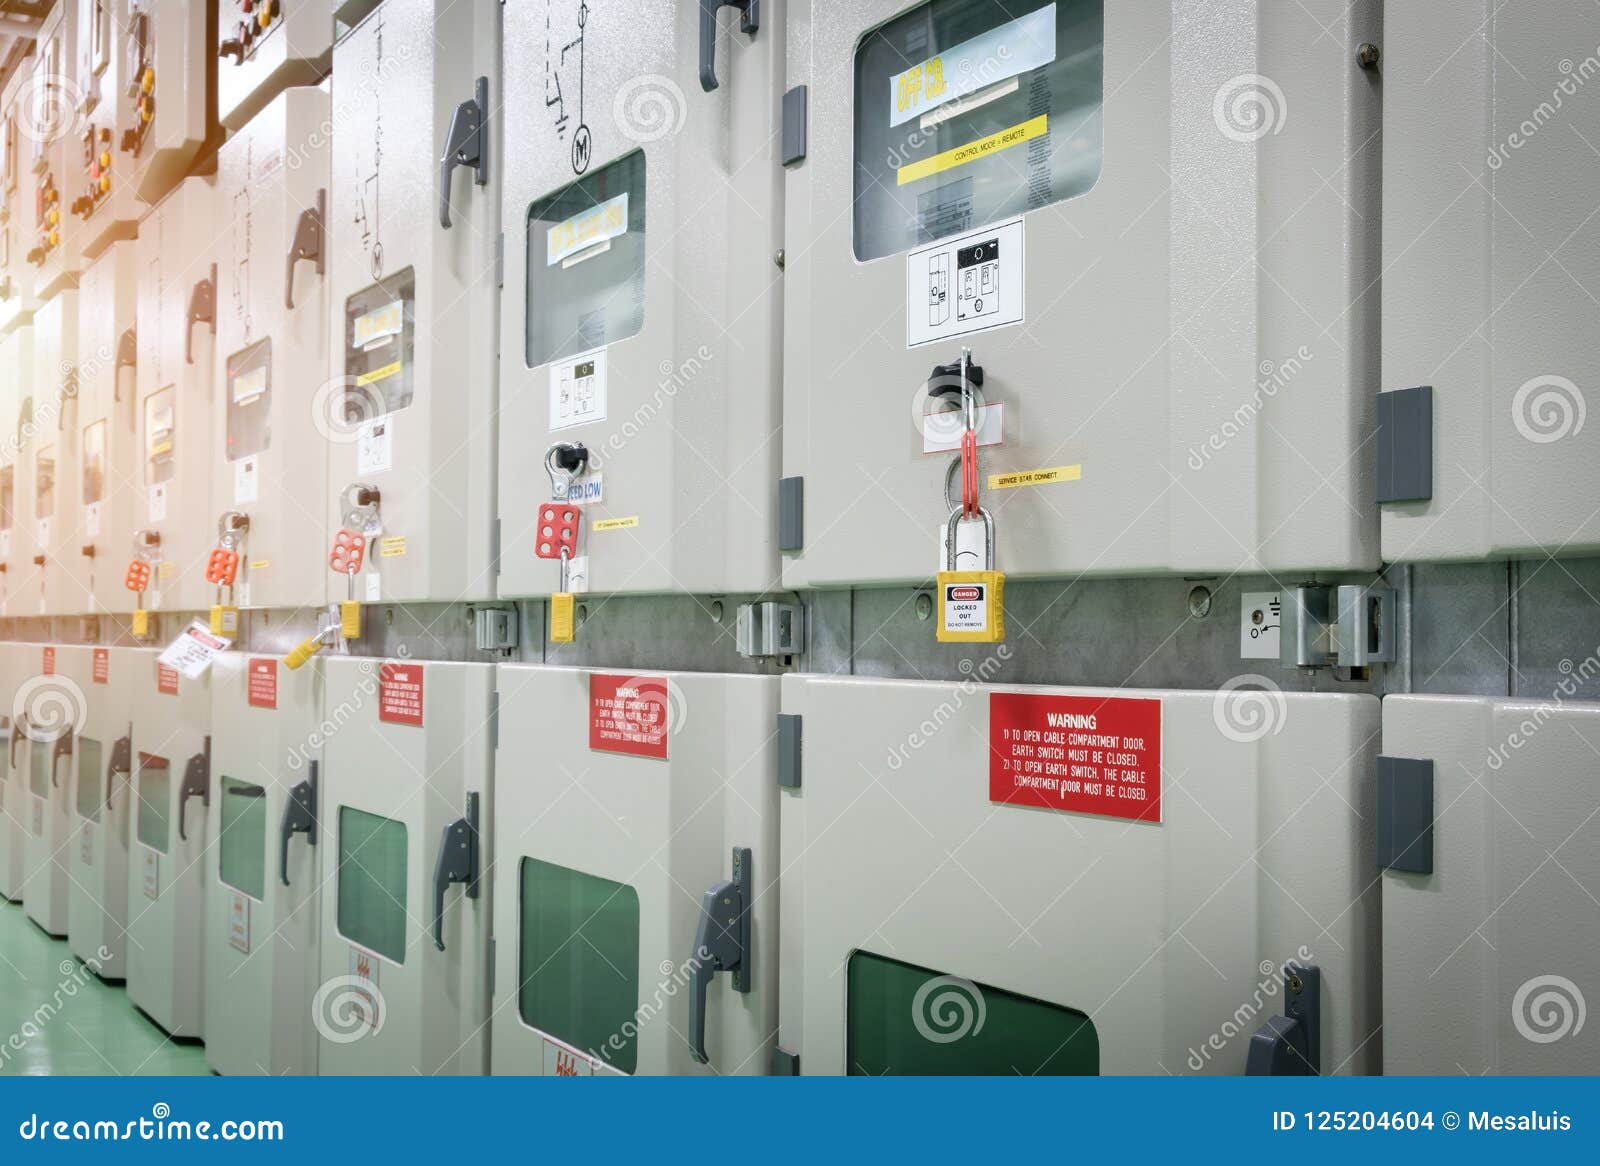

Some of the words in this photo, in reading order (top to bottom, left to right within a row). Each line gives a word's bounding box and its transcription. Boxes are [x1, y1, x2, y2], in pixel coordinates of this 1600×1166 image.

[897, 66, 921, 112] OFF
[954, 146, 979, 160] CONTROL
[980, 139, 996, 151] MODE
[1001, 128, 1025, 144] REMOTE
[585, 481, 601, 498] LOW
[998, 475, 1017, 485] SERVICE
[1034, 471, 1058, 481] CONNECT
[1047, 712, 1097, 730] WARNING
[1004, 728, 1009, 740] 1)
[1012, 729, 1021, 741] TO
[1024, 730, 1041, 742] OPEN
[1044, 731, 1065, 745] CABLE
[1068, 733, 1119, 749] COMPARTMENT
[1012, 744, 1034, 757] EARTH
[1037, 746, 1064, 760] SWITCH
[1068, 749, 1088, 762] MUST
[1092, 751, 1103, 764] BE
[1106, 752, 1140, 767] CLOSED.
[1003, 758, 1010, 770] 2)
[1013, 759, 1022, 772] TO
[1025, 760, 1042, 774] OPEN
[1045, 762, 1068, 776] EARTH
[1103, 768, 1118, 781] THE
[1121, 770, 1146, 784] CABLE
[1014, 774, 1060, 791] COMPARTMENT
[1061, 780, 1081, 793] DOOR
[1084, 782, 1103, 796] MUST
[1106, 784, 1116, 798] BE
[1119, 786, 1148, 801] CLOSED.
